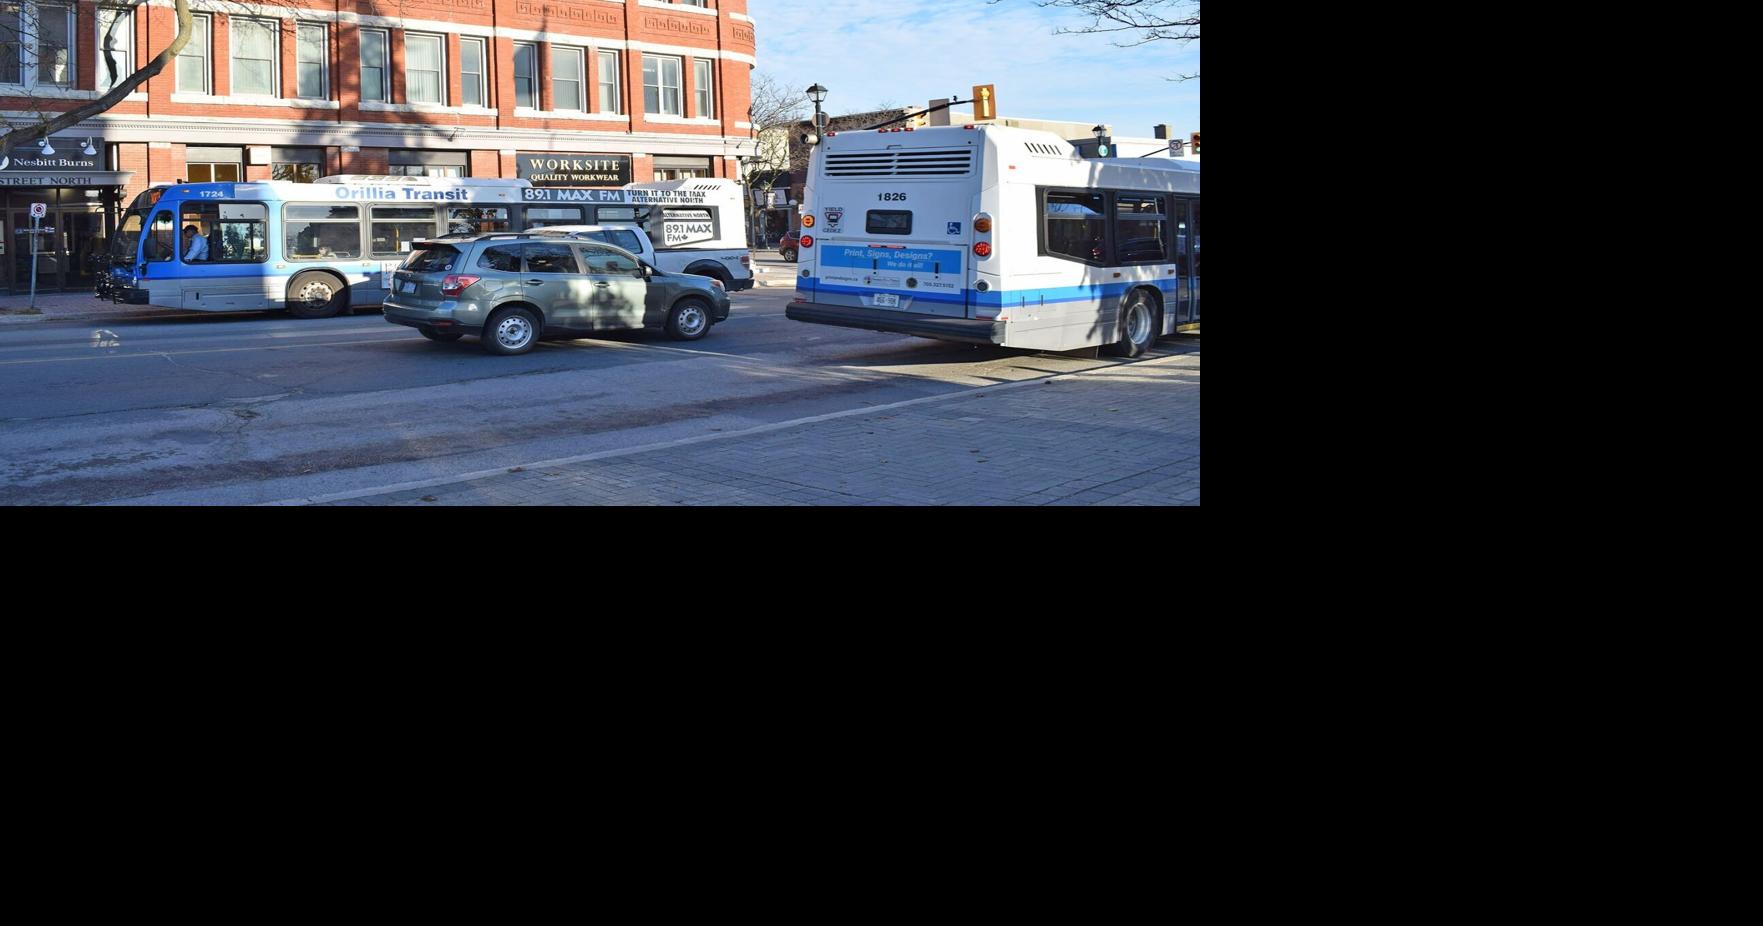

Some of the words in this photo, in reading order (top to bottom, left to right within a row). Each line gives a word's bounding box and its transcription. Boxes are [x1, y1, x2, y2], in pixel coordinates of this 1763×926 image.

[14, 158, 56, 167] Nesbitt
[59, 158, 94, 167] Burns
[530, 158, 620, 171] WORKSITE
[50, 177, 92, 185] NORTH
[531, 173, 569, 182] QUALITY
[571, 174, 619, 182] WORKWEAR
[200, 190, 224, 198] 1724
[335, 186, 396, 199] Orillia
[402, 187, 469, 200] Transit
[525, 188, 551, 200] 89.1
[557, 189, 594, 201] MAX
[600, 190, 621, 201] FM
[627, 189, 649, 197] TURN
[878, 192, 907, 201] 1826
[631, 196, 678, 204] ALTERNATIVE
[665, 224, 684, 233] 89.1
[686, 224, 712, 233] MAX
[667, 234, 681, 242] FM
[844, 248, 865, 258] Print,
[867, 249, 892, 260] Signs,
[894, 250, 933, 261] Designs?
